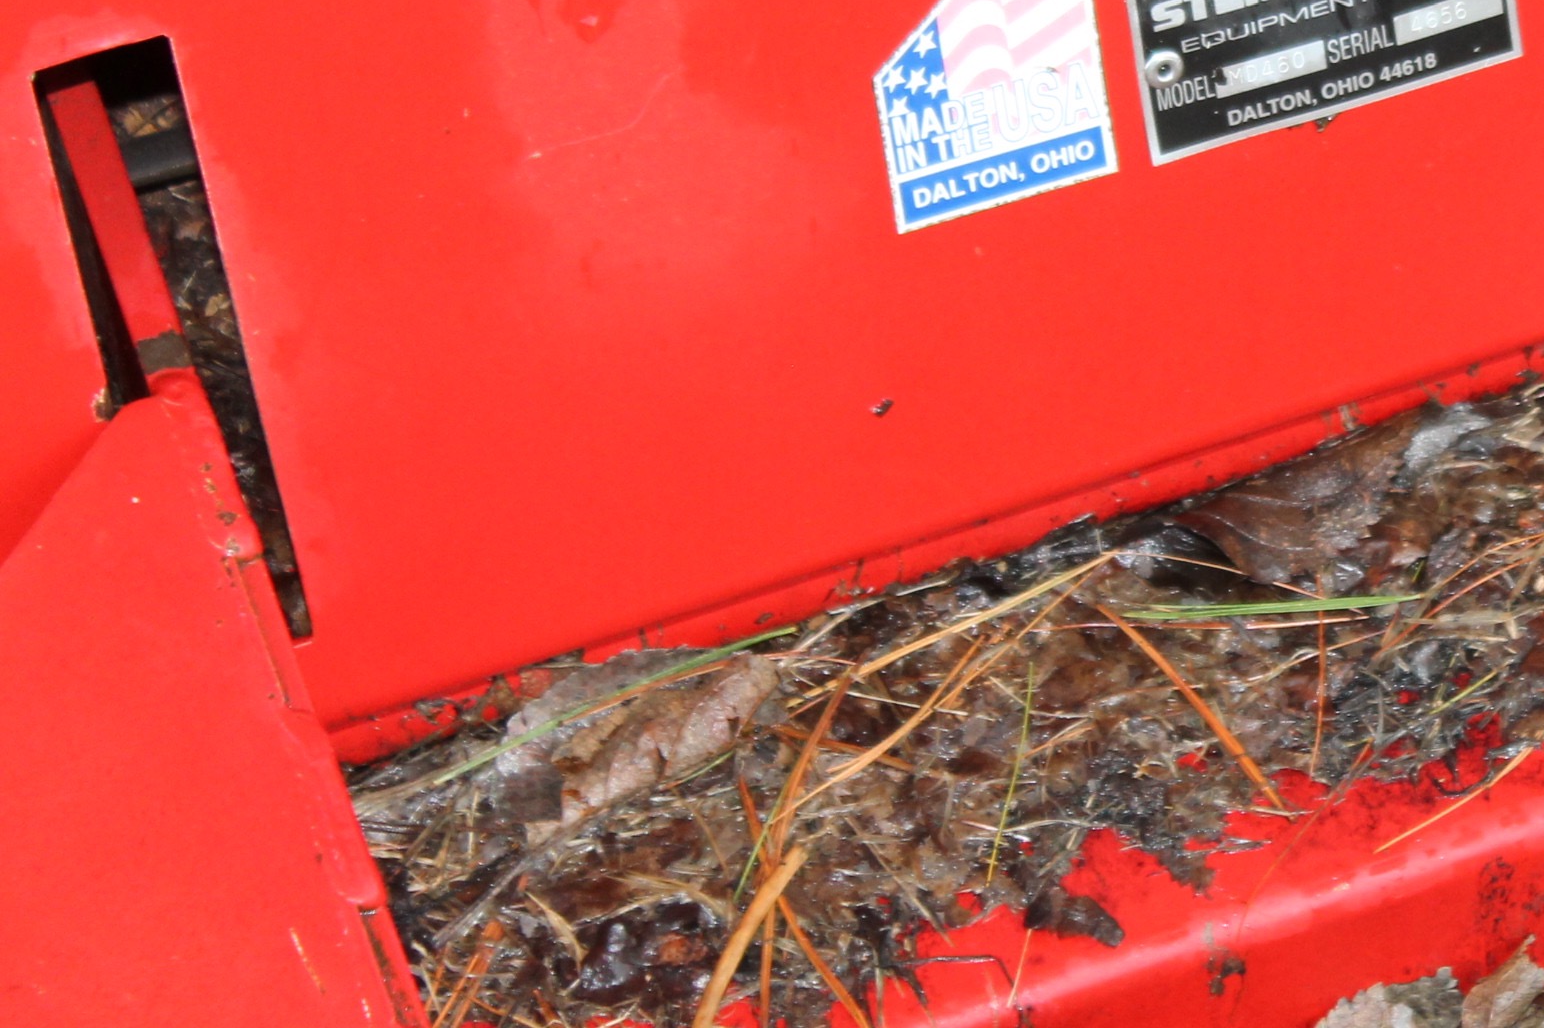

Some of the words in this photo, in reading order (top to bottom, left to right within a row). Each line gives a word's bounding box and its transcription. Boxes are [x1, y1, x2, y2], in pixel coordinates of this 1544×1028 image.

[1156, 75, 1215, 112] MODEL
[1327, 25, 1394, 64] SERIAL
[1410, 4, 1467, 33] 4656
[1227, 89, 1318, 127] DALTON,
[1321, 73, 1375, 100] OHIO
[1379, 53, 1437, 83] 44618
[891, 91, 986, 147] MADE
[992, 61, 1100, 143] USA
[896, 141, 928, 173] IN
[931, 123, 993, 163] THE
[912, 161, 1026, 209] DALTON,
[1030, 140, 1095, 174] OHIO
